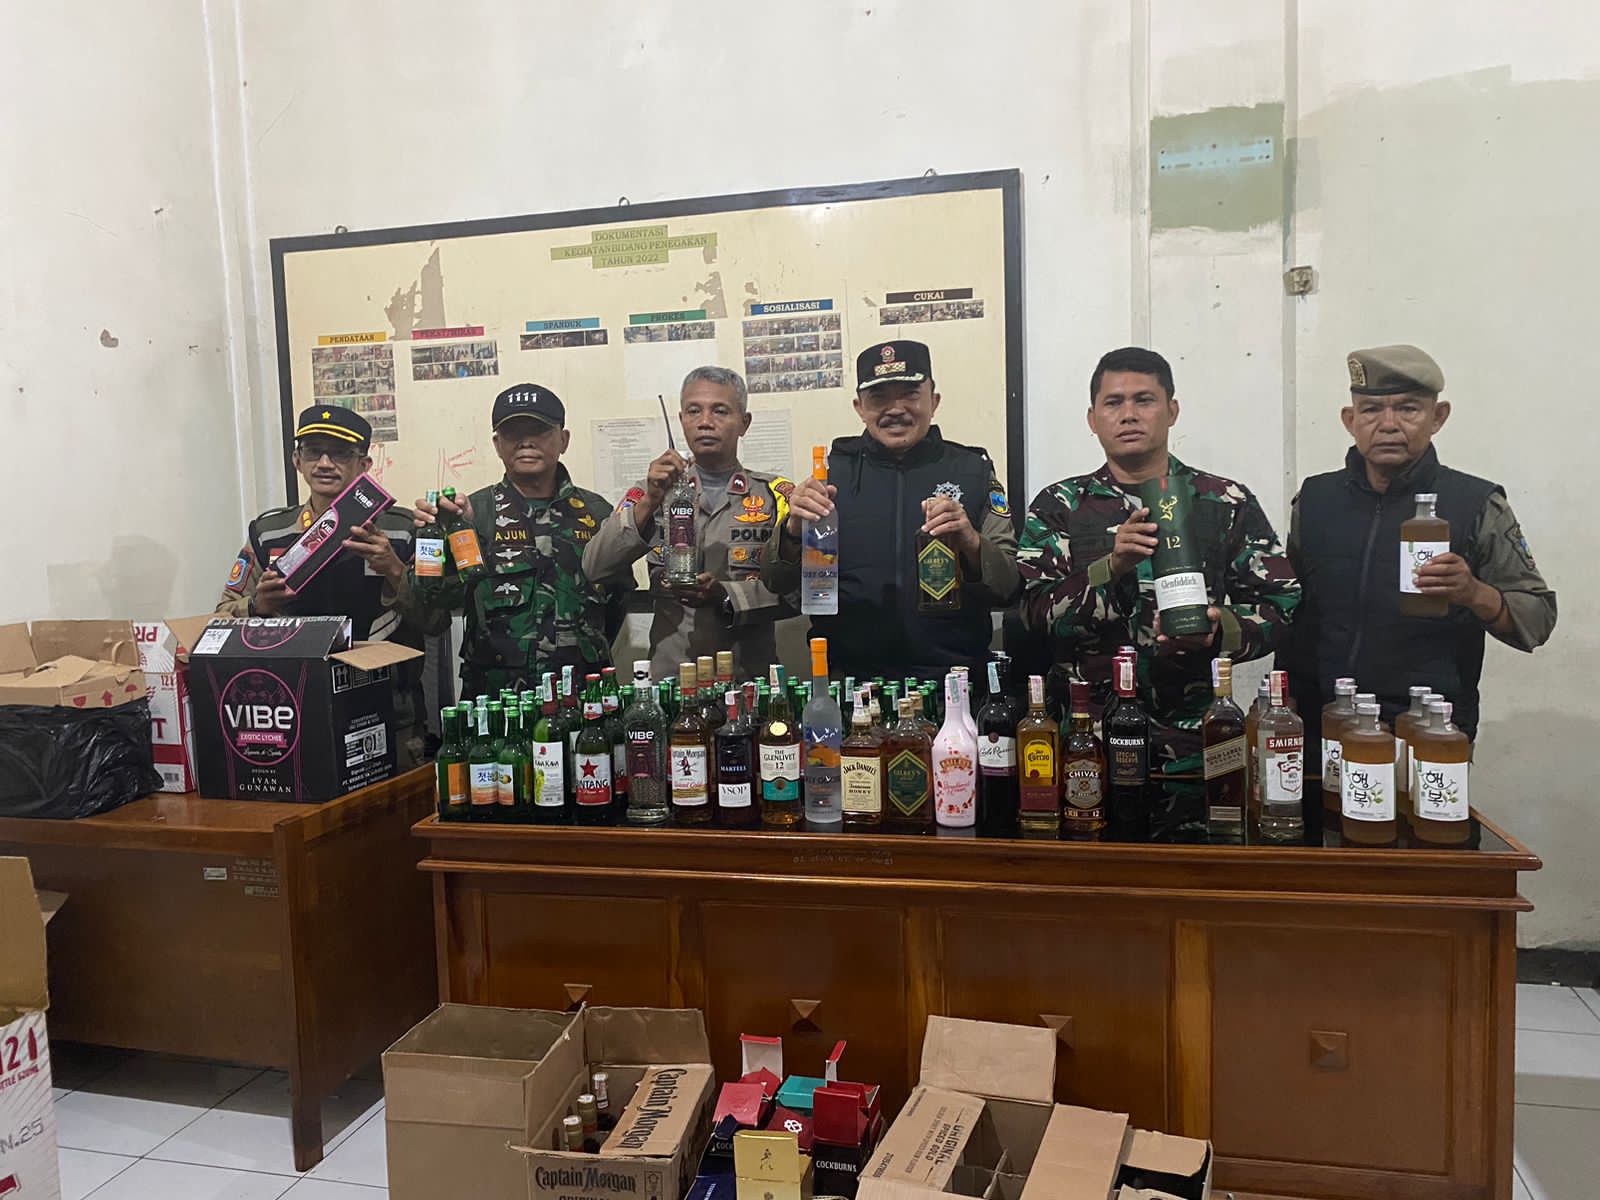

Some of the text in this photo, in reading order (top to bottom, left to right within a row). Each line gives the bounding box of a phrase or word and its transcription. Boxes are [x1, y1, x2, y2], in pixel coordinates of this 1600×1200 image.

[595, 231, 664, 241] DOKUMENTASI
[602, 254, 659, 265] TAHUN 2022
[914, 291, 945, 301] CUKAI
[763, 302, 820, 313] SOSIALISASI
[543, 320, 582, 329] SPANDUK
[329, 335, 375, 344] PENDATAAN
[1166, 536, 1181, 549] 12
[763, 753, 796, 761] GLENLIVET
[775, 761, 785, 769] 12
[843, 763, 857, 775] JACK
[1068, 770, 1099, 778] CHIVAS
[252, 777, 277, 785] IVAN
[239, 783, 292, 793] GUNAWAN
[621, 1068, 687, 1150] Captain Morgan
[535, 1166, 637, 1193] Captain Morgan
